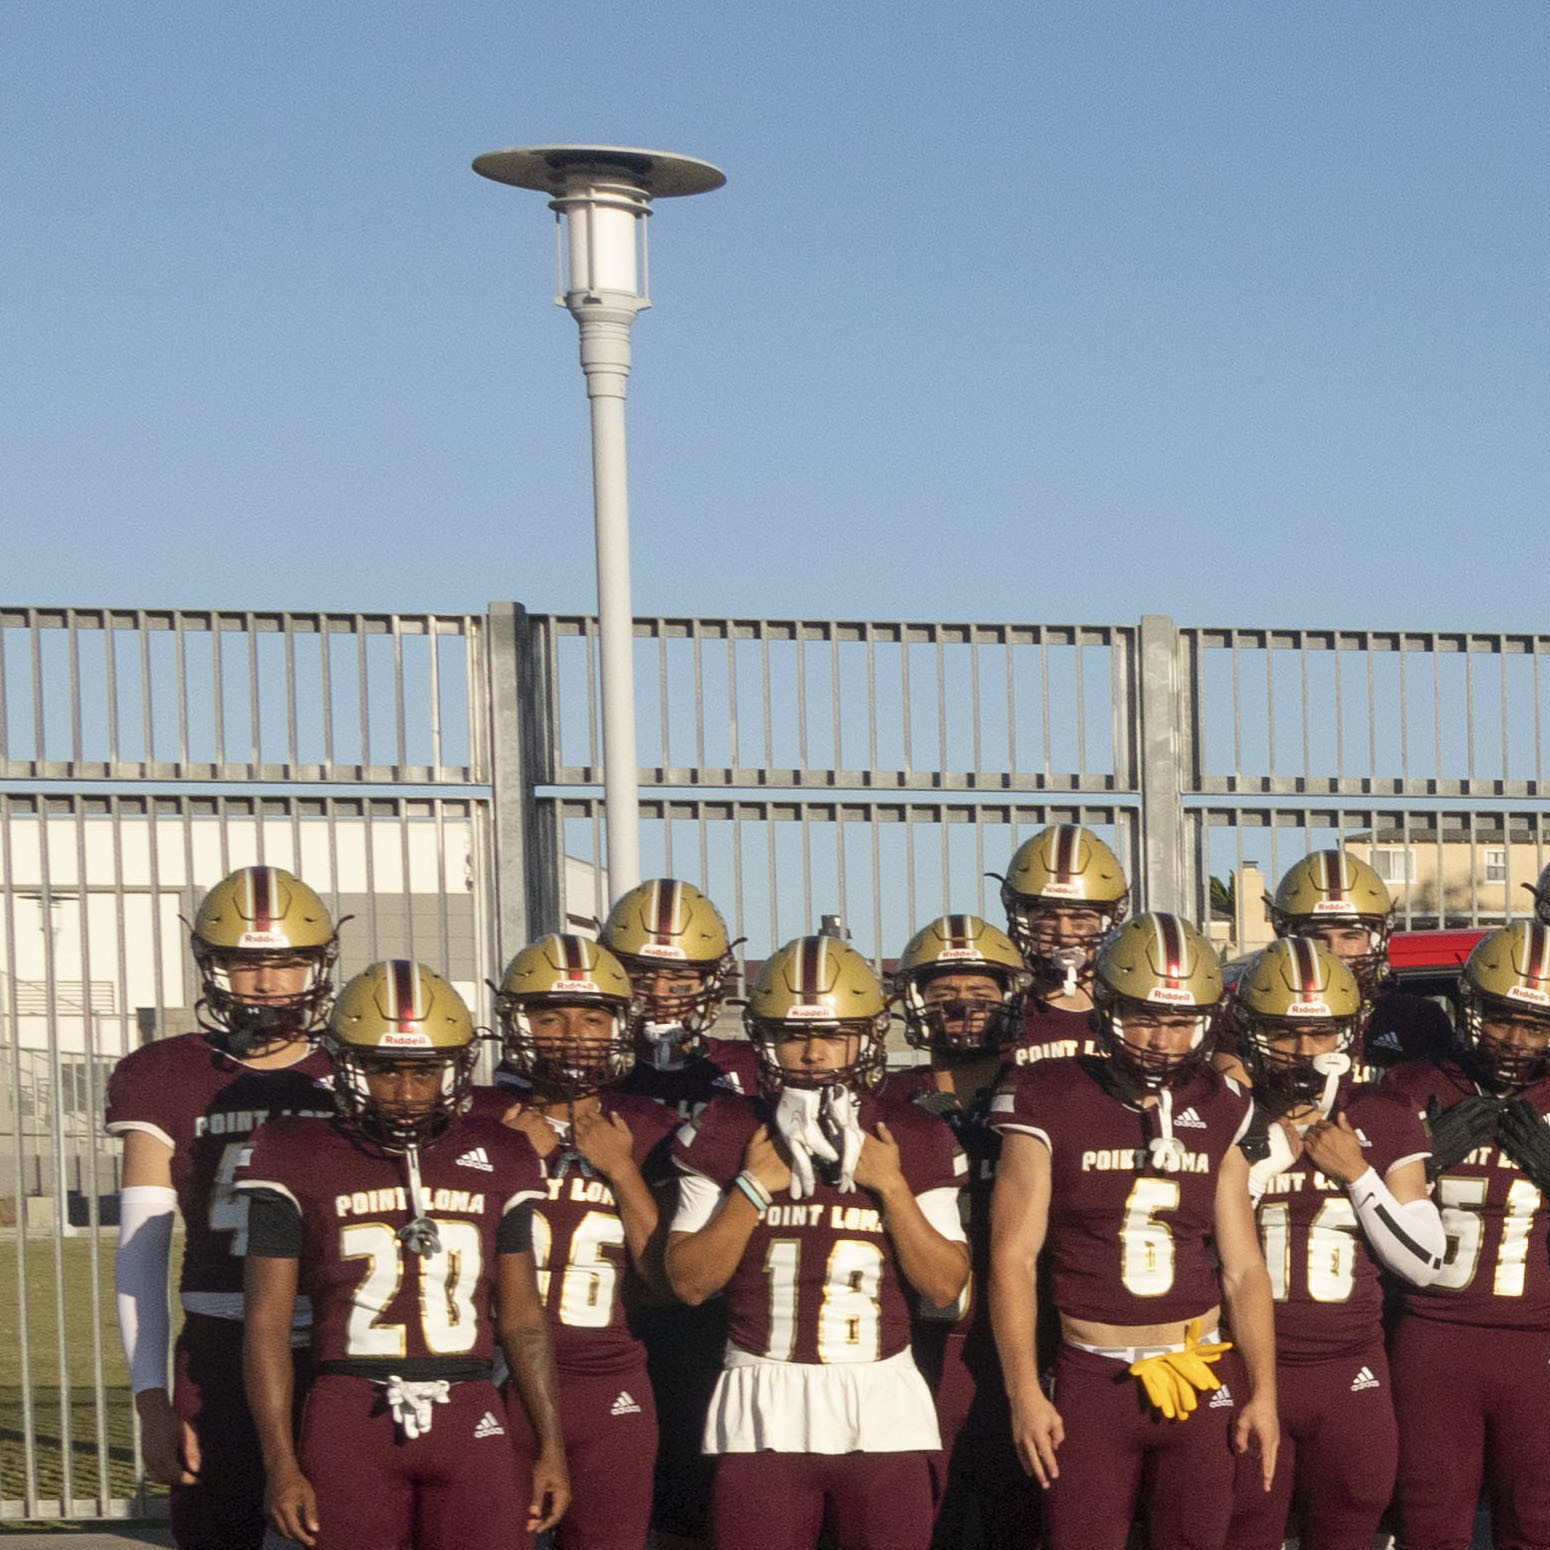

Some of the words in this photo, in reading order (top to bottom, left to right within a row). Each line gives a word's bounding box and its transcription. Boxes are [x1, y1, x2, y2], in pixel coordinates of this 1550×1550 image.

[1154, 991, 1190, 1001] Riddell
[1292, 1005, 1326, 1014] Riddell
[385, 1035, 424, 1045] Riddell
[1015, 1038, 1078, 1066] POINT
[1082, 1148, 1148, 1172] POINT
[335, 1186, 408, 1217] POINT
[421, 1187, 485, 1215] LOMA
[831, 1204, 883, 1233] LOM
[1119, 1176, 1181, 1298] 6
[762, 1238, 884, 1364] 18
